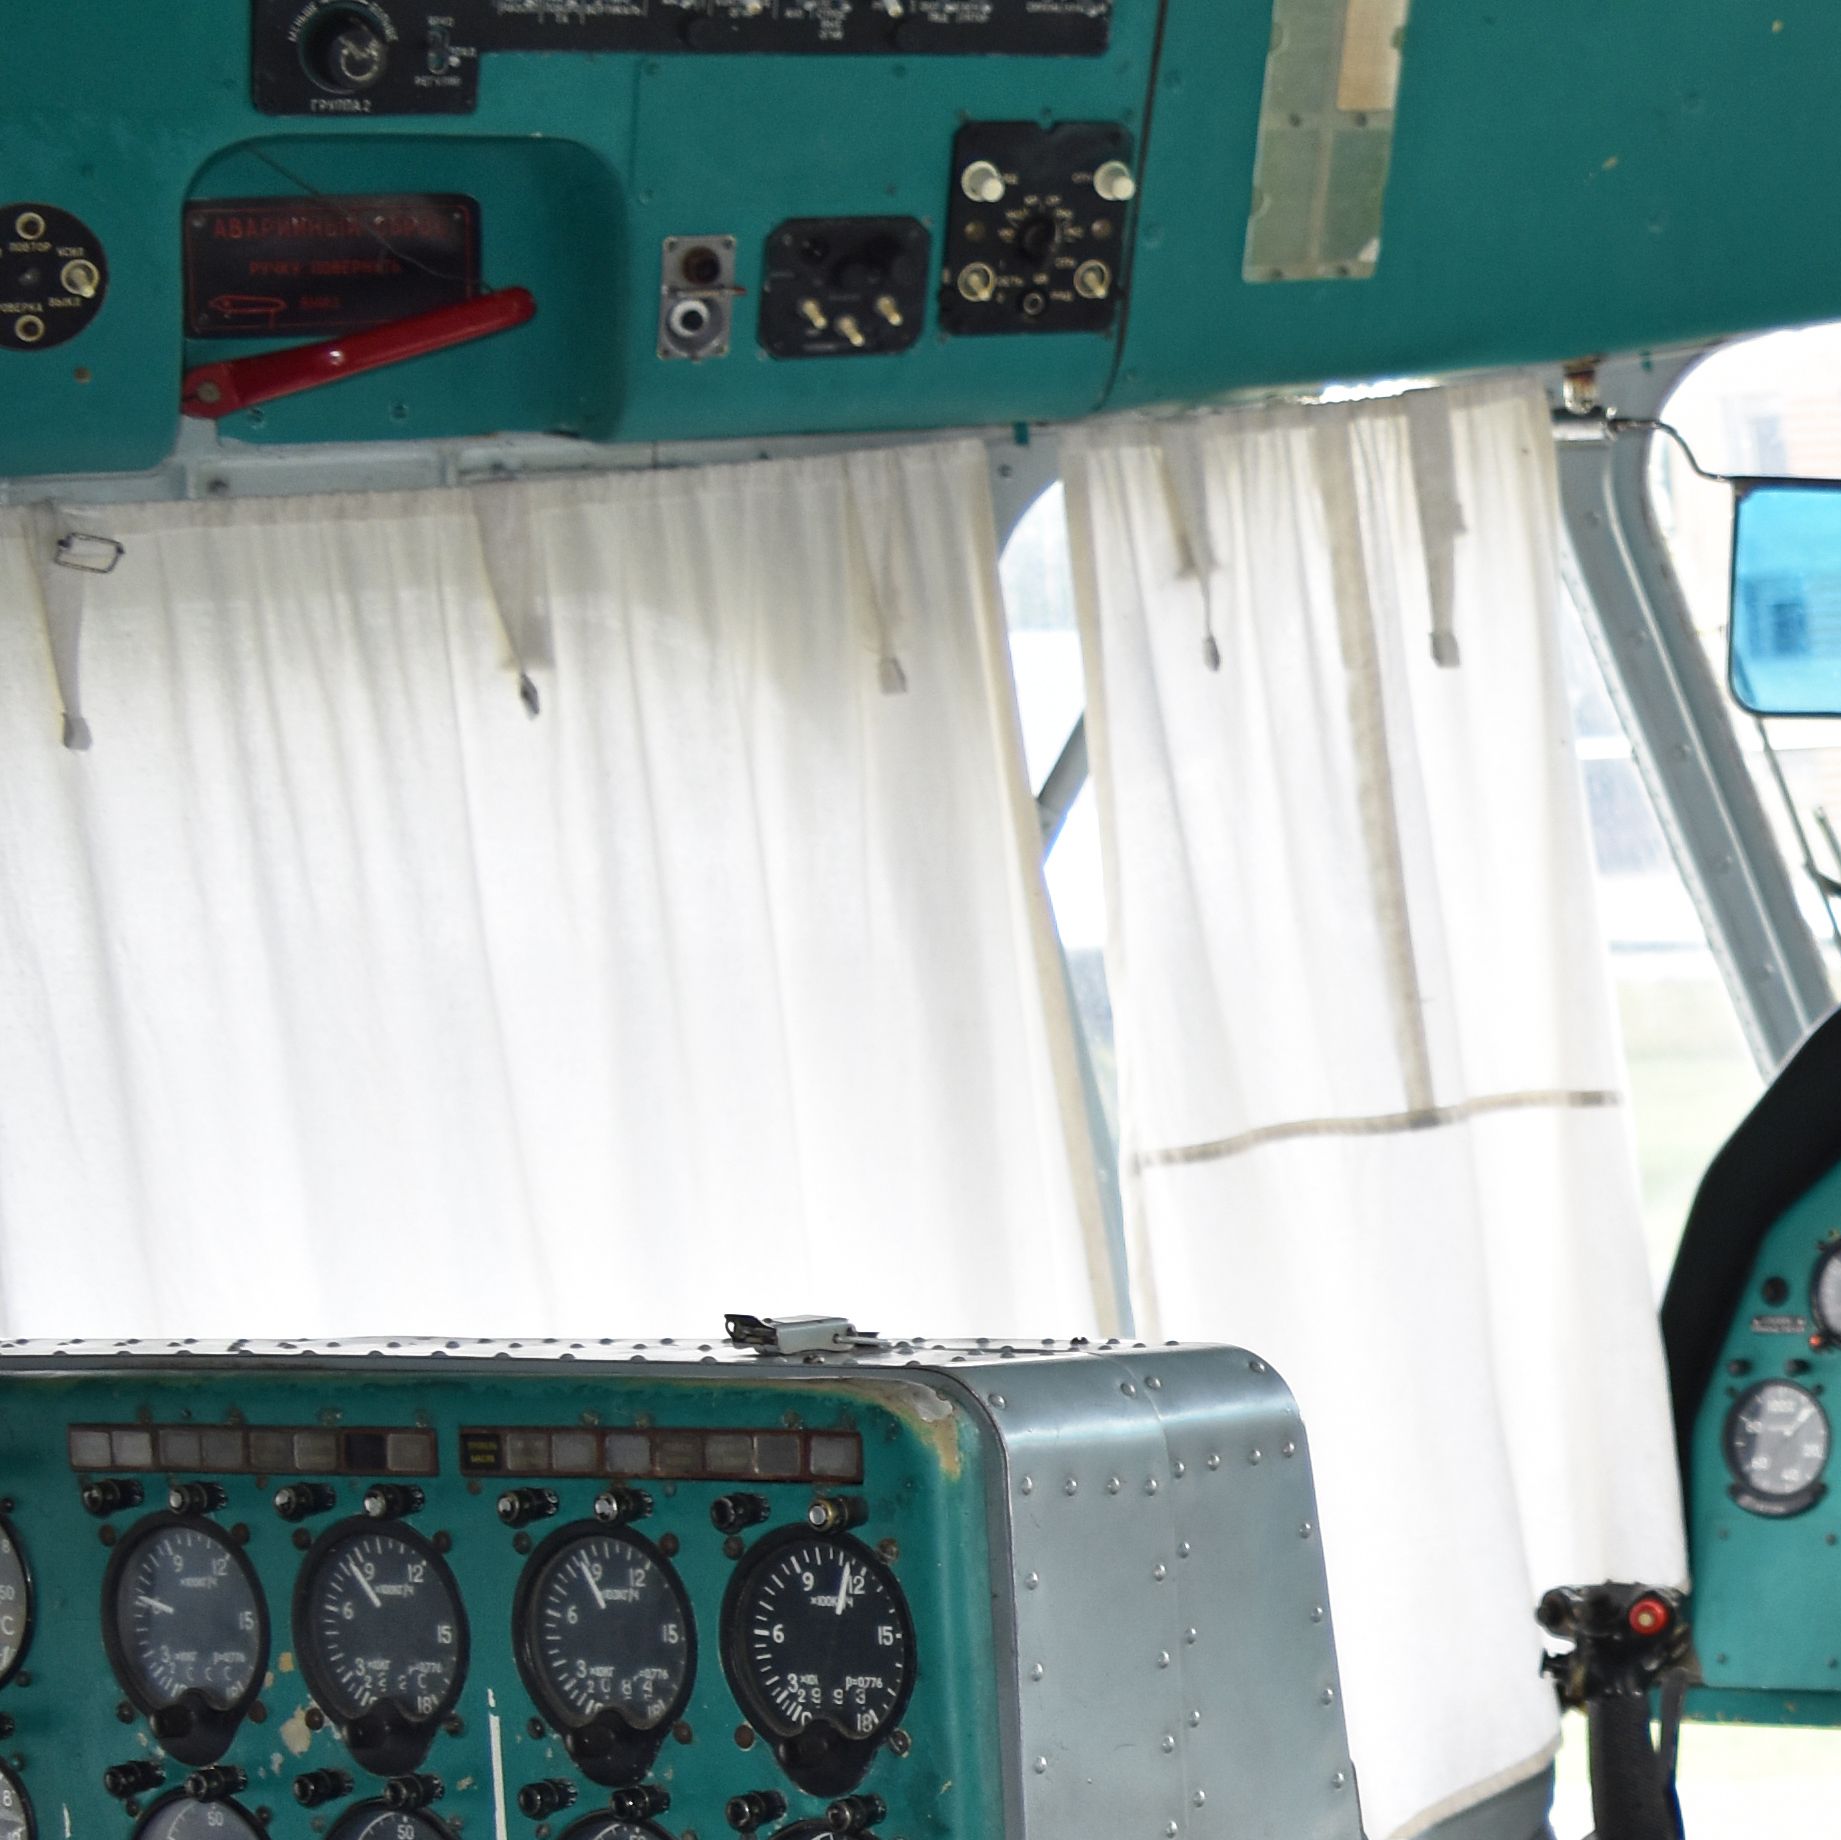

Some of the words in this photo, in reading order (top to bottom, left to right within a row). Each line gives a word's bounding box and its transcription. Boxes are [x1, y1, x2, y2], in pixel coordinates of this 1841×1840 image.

[802, 1572, 815, 1591] 9
[848, 1575, 865, 1595] 12
[772, 1624, 785, 1644] 6
[878, 1626, 893, 1646] 15
[787, 1672, 798, 1692] 3
[857, 1712, 873, 1733] 18
[208, 1812, 224, 1827] 50
[397, 1824, 414, 1840] 50
